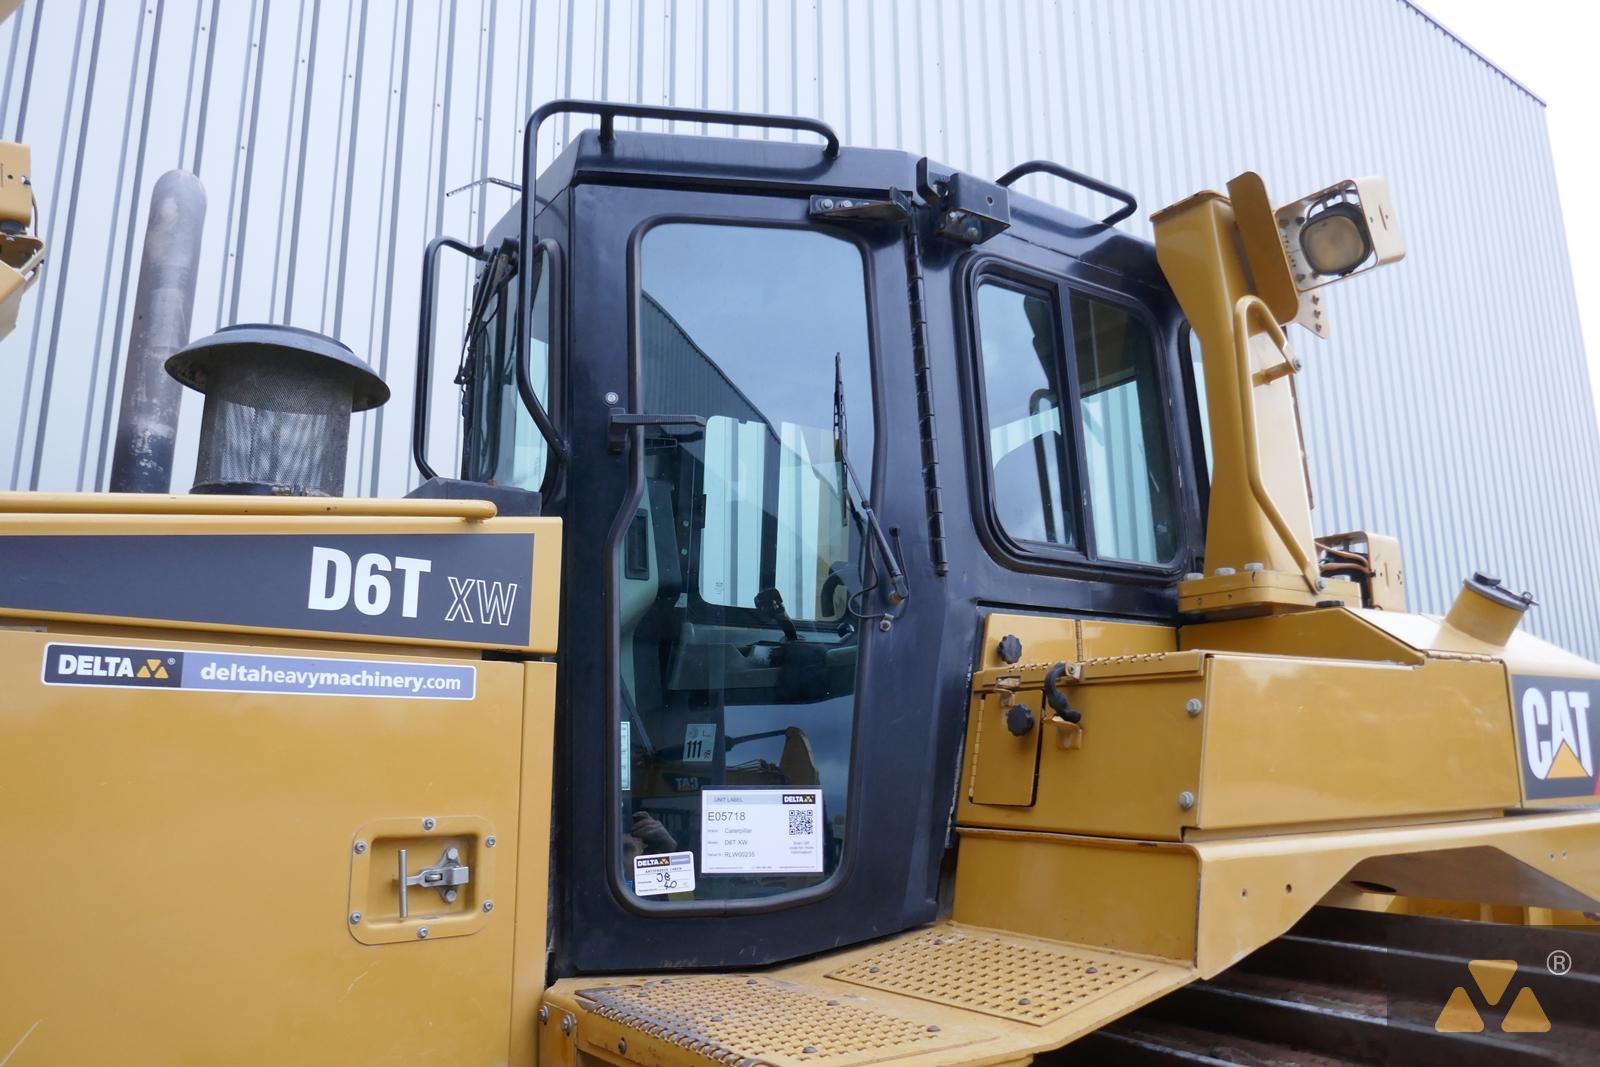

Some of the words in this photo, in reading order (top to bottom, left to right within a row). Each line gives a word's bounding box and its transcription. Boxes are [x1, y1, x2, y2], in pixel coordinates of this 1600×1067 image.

[308, 546, 432, 618] D6T
[444, 576, 518, 626] XW
[58, 654, 134, 678] DELTA
[200, 662, 461, 693] deltaheavymachinery.com
[1522, 687, 1594, 780] CAT
[687, 740, 702, 759] 111
[707, 811, 746, 821] E05718
[637, 859, 660, 867] DELTA
